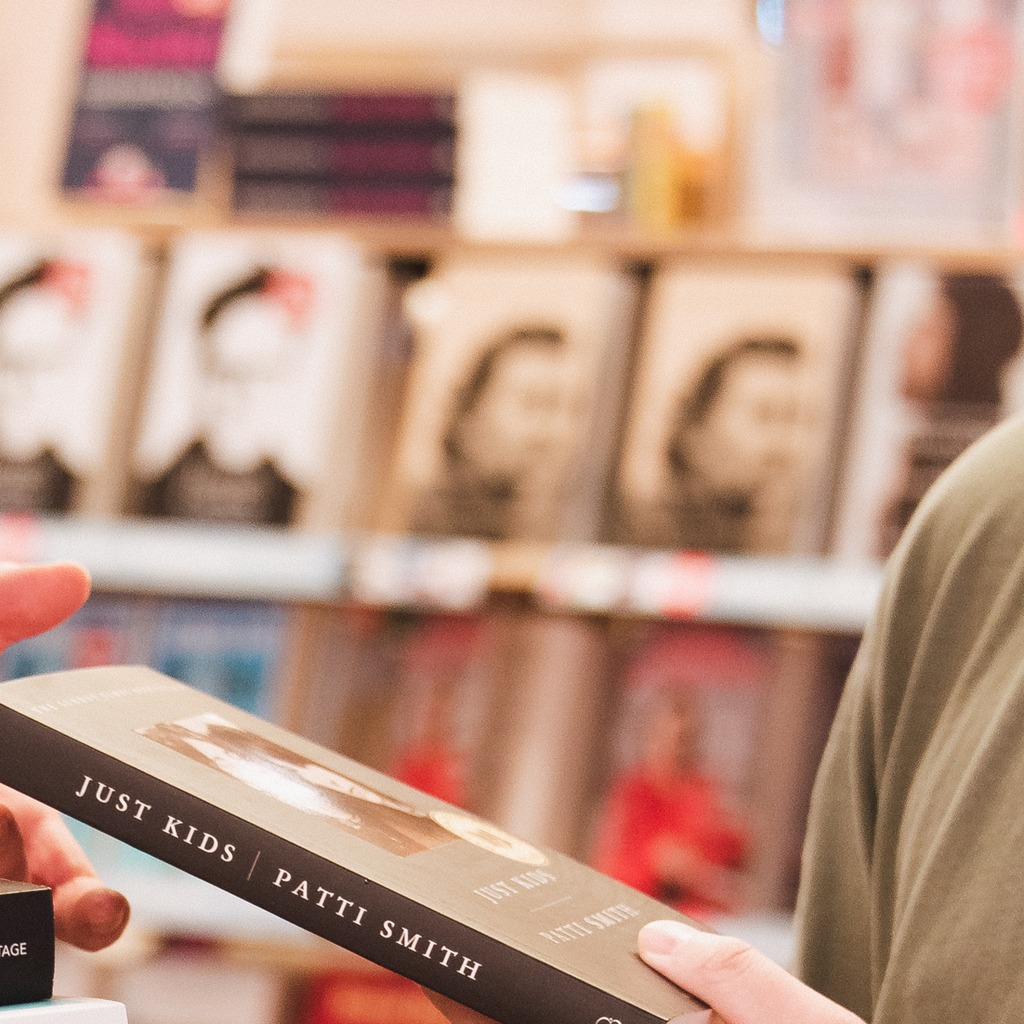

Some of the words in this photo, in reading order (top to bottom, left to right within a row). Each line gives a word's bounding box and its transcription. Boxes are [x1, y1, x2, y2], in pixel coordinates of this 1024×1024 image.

[75, 775, 152, 821] JUST
[162, 815, 237, 862] KIDS
[272, 868, 368, 926] PATTI
[379, 920, 483, 980] SMITH
[473, 880, 519, 905] JUST
[538, 920, 593, 945] PATTI
[583, 902, 642, 931] SMITH
